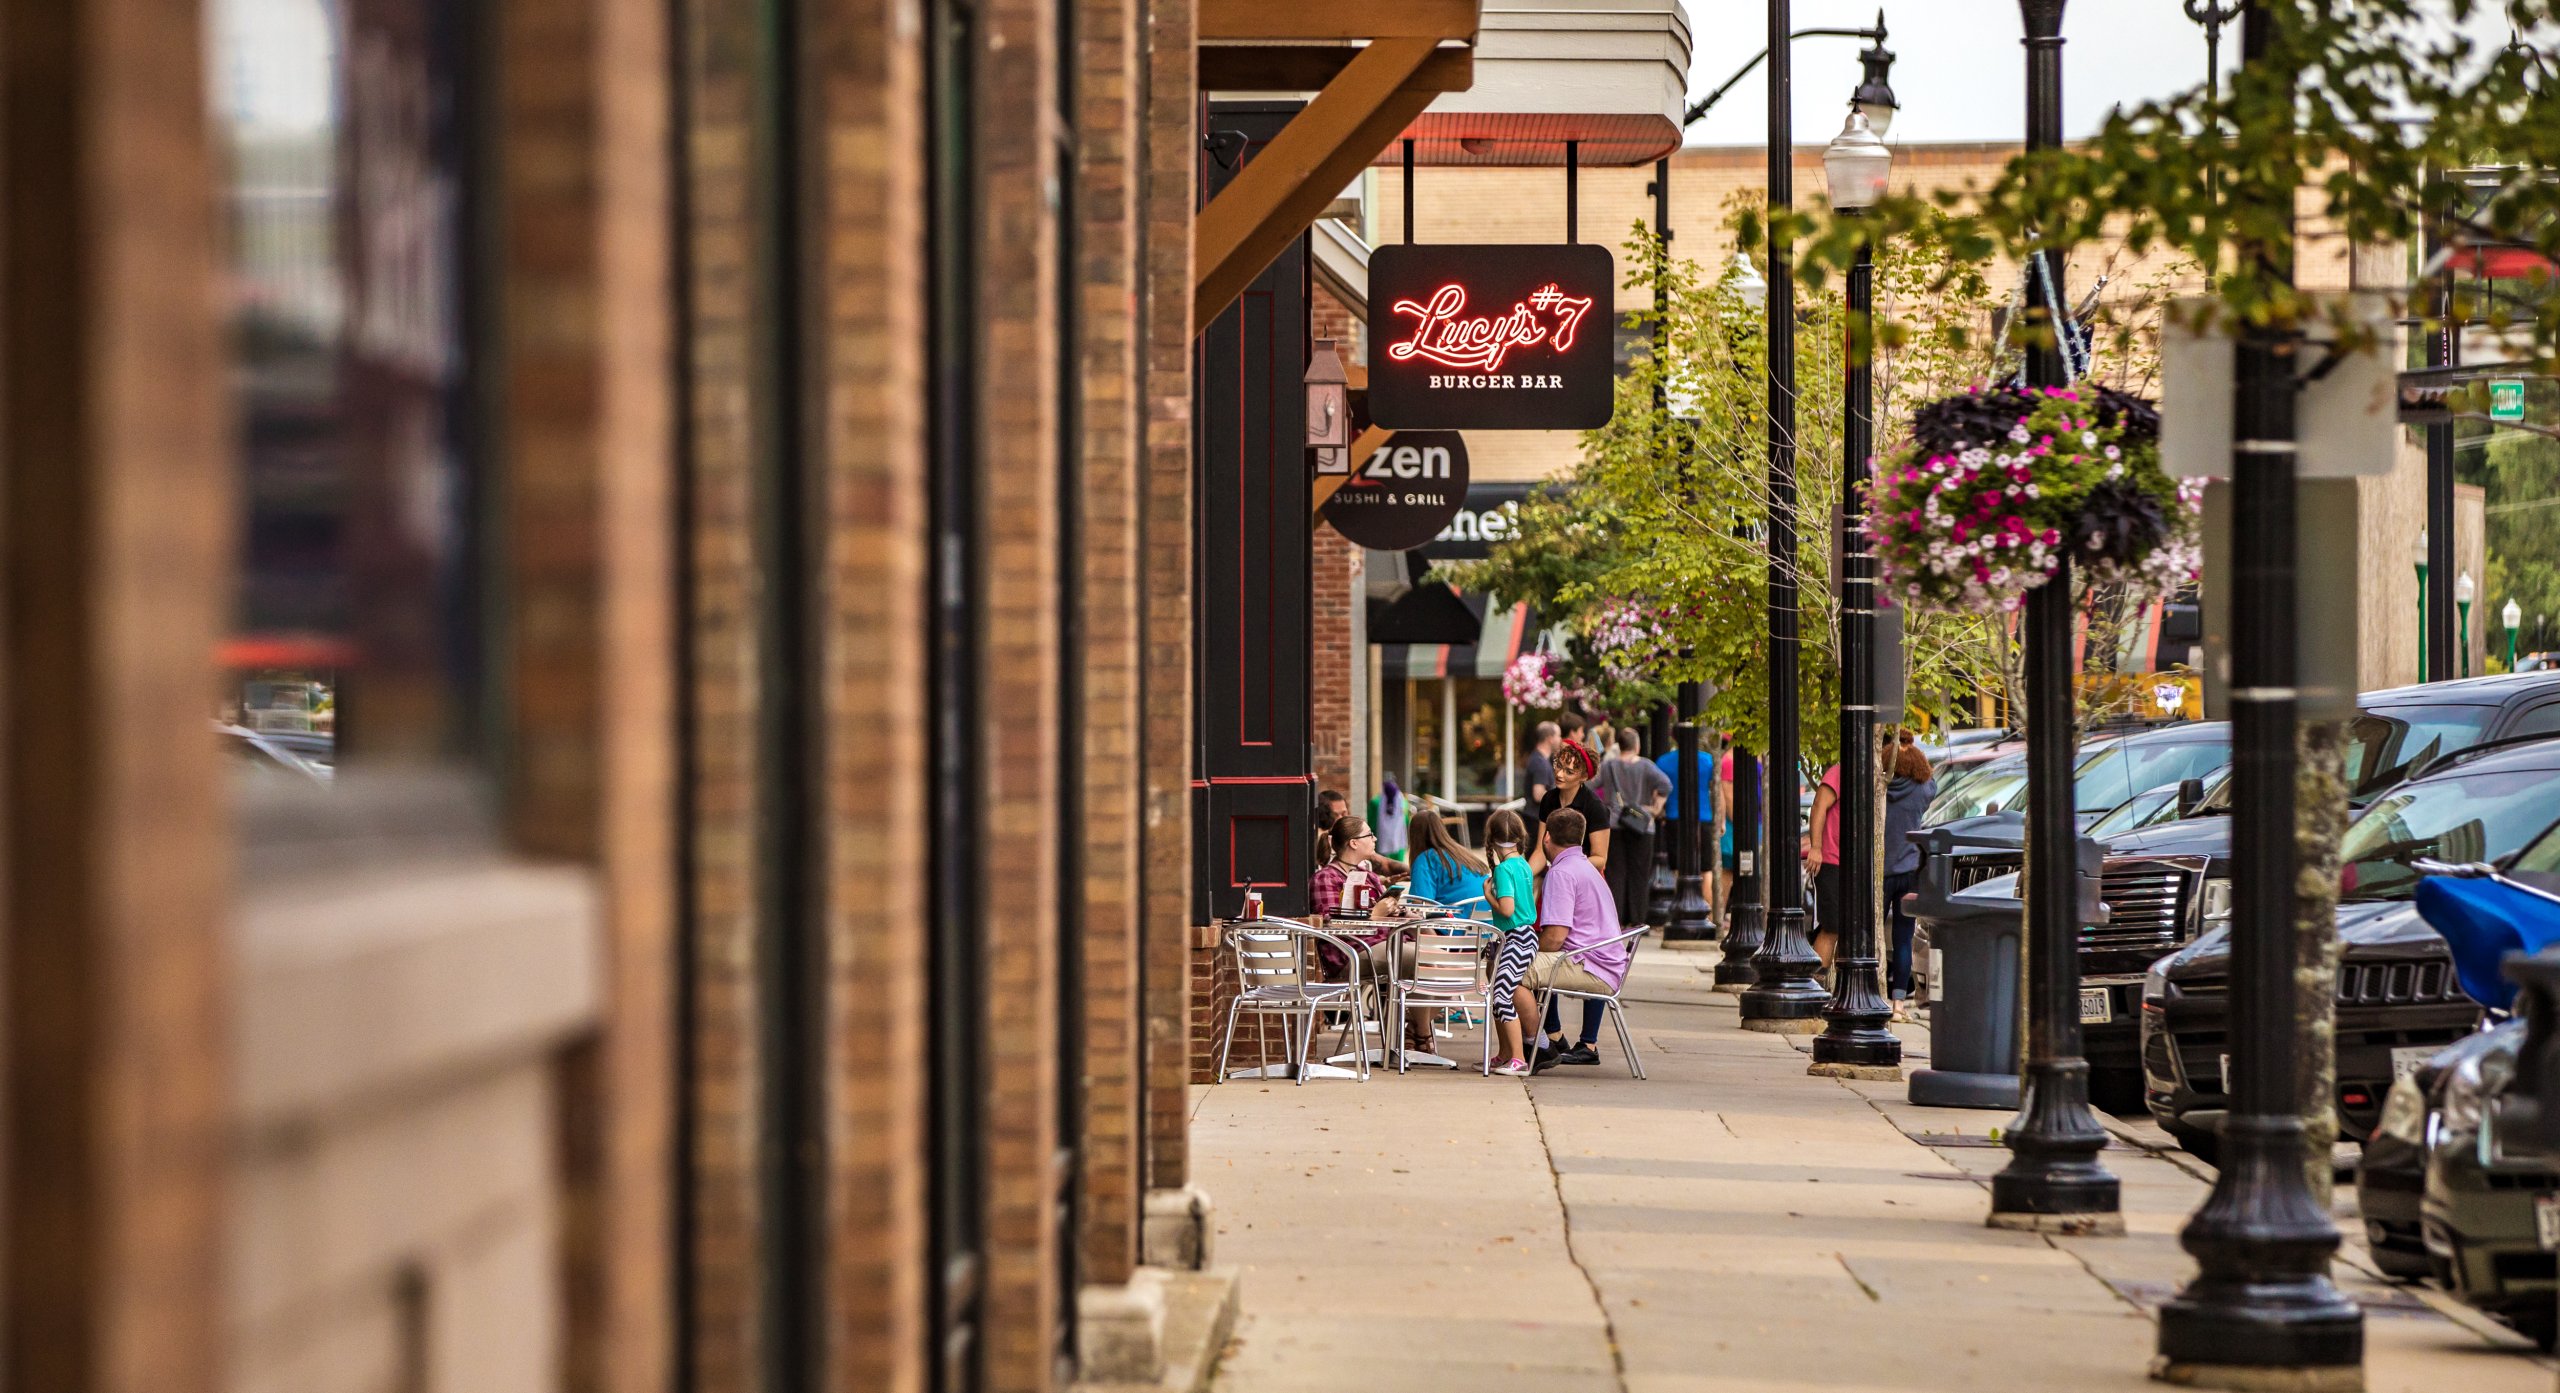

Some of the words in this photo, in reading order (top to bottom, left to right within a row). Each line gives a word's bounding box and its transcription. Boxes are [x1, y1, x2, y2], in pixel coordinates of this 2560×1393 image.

[1388, 284, 1546, 372] Lucy's
[1429, 375, 1516, 389] BURGER
[1521, 375, 1564, 389] BAR
[1364, 445, 1451, 479] zen
[1334, 492, 1381, 505] SUSHI
[1386, 492, 1398, 506] &
[1404, 493, 1447, 507] GRILL
